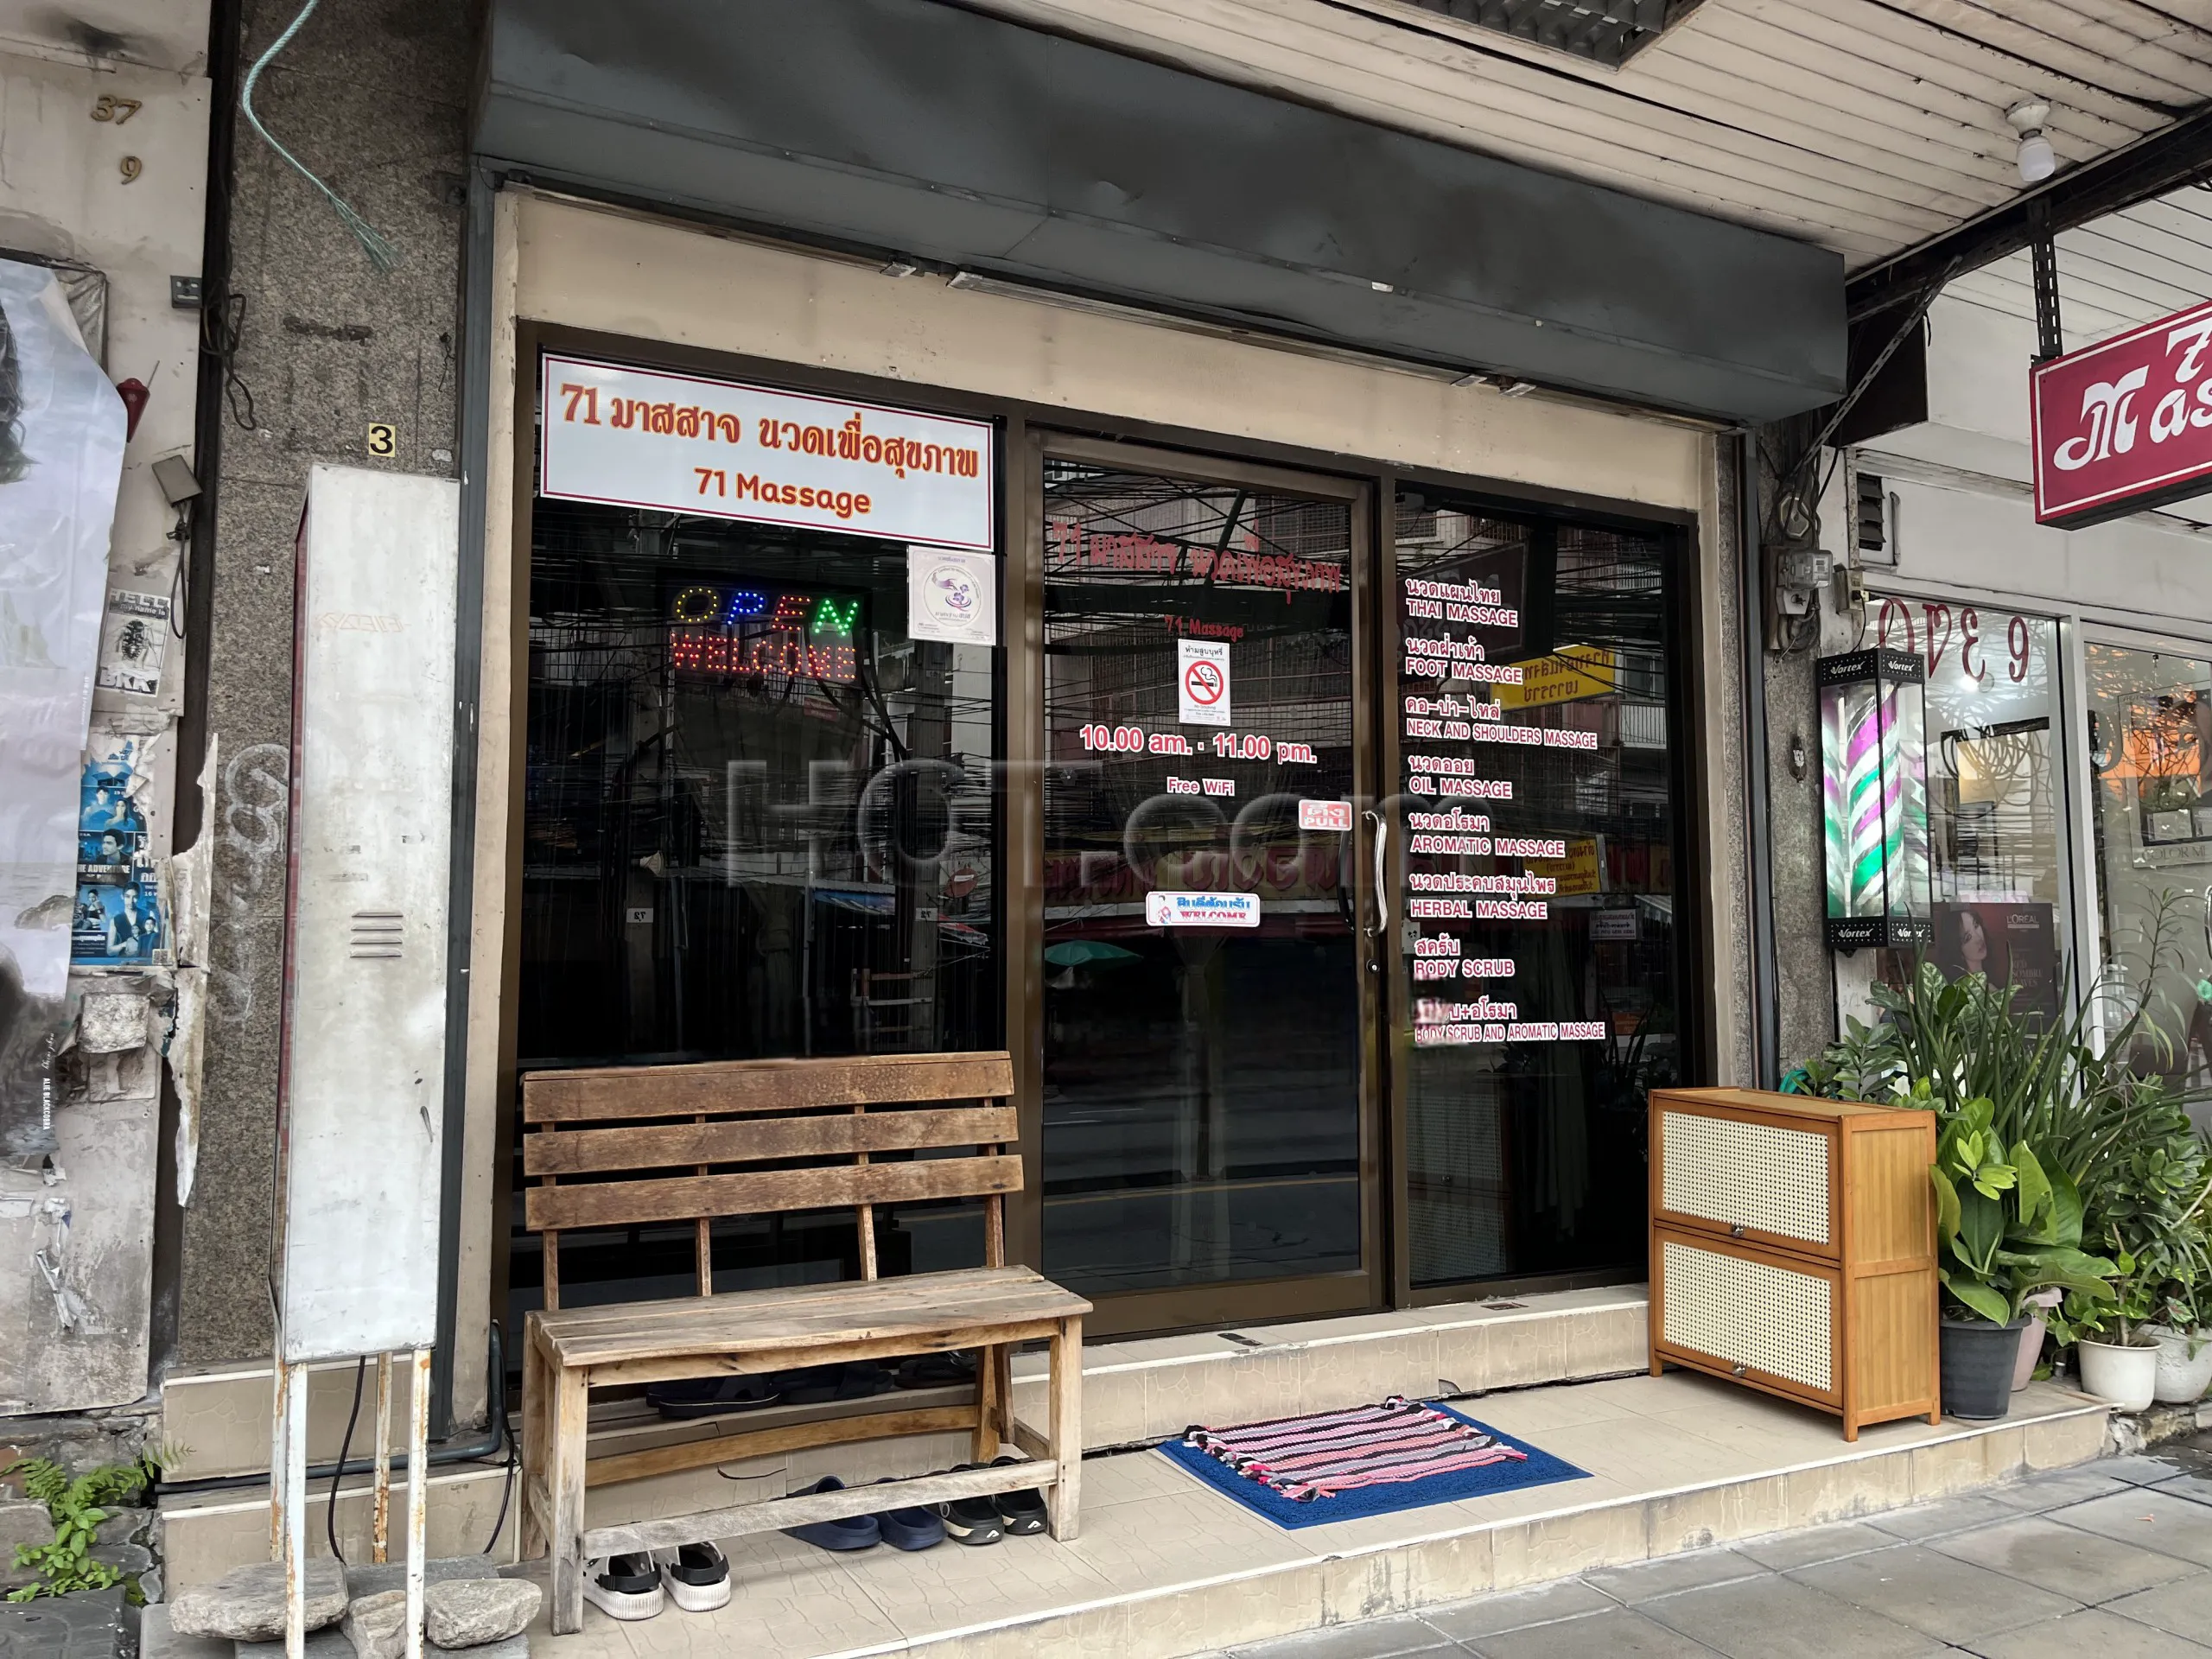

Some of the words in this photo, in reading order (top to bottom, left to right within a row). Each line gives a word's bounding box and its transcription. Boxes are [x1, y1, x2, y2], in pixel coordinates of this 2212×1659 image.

[90, 95, 142, 125] 37
[120, 156, 142, 185] 9
[370, 425, 394, 454] 3
[561, 383, 601, 426] 71
[610, 397, 741, 444] มาสสาจ
[759, 412, 979, 479] นวดเพื่อสุขภาพ
[696, 468, 726, 497] 71
[737, 474, 872, 518] Massage
[1053, 522, 1081, 566] 71
[1405, 578, 1501, 605] นวดแผนไทย
[135, 606, 156, 614] name
[672, 588, 858, 636] OPEN
[1406, 599, 1442, 620] THAI
[1447, 603, 1518, 627] MASSAGE
[1165, 616, 1184, 634] 71
[1189, 618, 1243, 639] Massage
[671, 632, 855, 680] WELCOME
[1185, 645, 1223, 657] ห้ามสูบบุหรี่
[1405, 632, 1484, 661] นวดฝ่าเท้า
[1405, 657, 1448, 677] FOOT
[1452, 661, 1522, 685] MASSAGE
[1830, 661, 1866, 675] Vortex
[1888, 660, 1915, 672] Vortex
[1405, 694, 1501, 720] คอ-บ่า-ไหล่
[1079, 725, 1142, 753] 10.00
[1149, 732, 1193, 756] am.
[1212, 732, 1271, 760] 11.00
[1277, 740, 1318, 765] pm.
[1406, 718, 1441, 737] NECK
[1445, 721, 1470, 739] AND
[1472, 722, 1541, 745] SHOULDERS
[1544, 730, 1598, 750] MASSAGE
[1408, 753, 1475, 775] นวดออย
[1166, 776, 1200, 796] Free
[1202, 778, 1235, 798] WiFi
[1408, 777, 1435, 795] OIL
[1440, 779, 1512, 799] MASSAGE
[1304, 812, 1348, 827] PULL
[1408, 806, 1490, 832] นวดอโรมา
[1410, 835, 1492, 855] AROMATIC
[1494, 837, 1566, 858] MASSAGE
[1408, 869, 1555, 899] นวดประคบสมุนไพร
[1410, 899, 1472, 918] HERBAL
[1476, 901, 1548, 919] MASSAGE
[1414, 933, 1460, 957] สครับ
[1838, 927, 1874, 938] Vortex
[1897, 927, 1925, 938] Vorx
[1462, 958, 1515, 976] SCRUB
[1446, 1024, 1481, 1043] SCRUB
[1483, 1024, 1506, 1042] AND
[1507, 1022, 1558, 1042] AROMATIC
[1560, 1021, 1605, 1040] MASSAGE
[42, 1077, 51, 1091] ALIE
[42, 1091, 51, 1131] BLACKCOBRA
